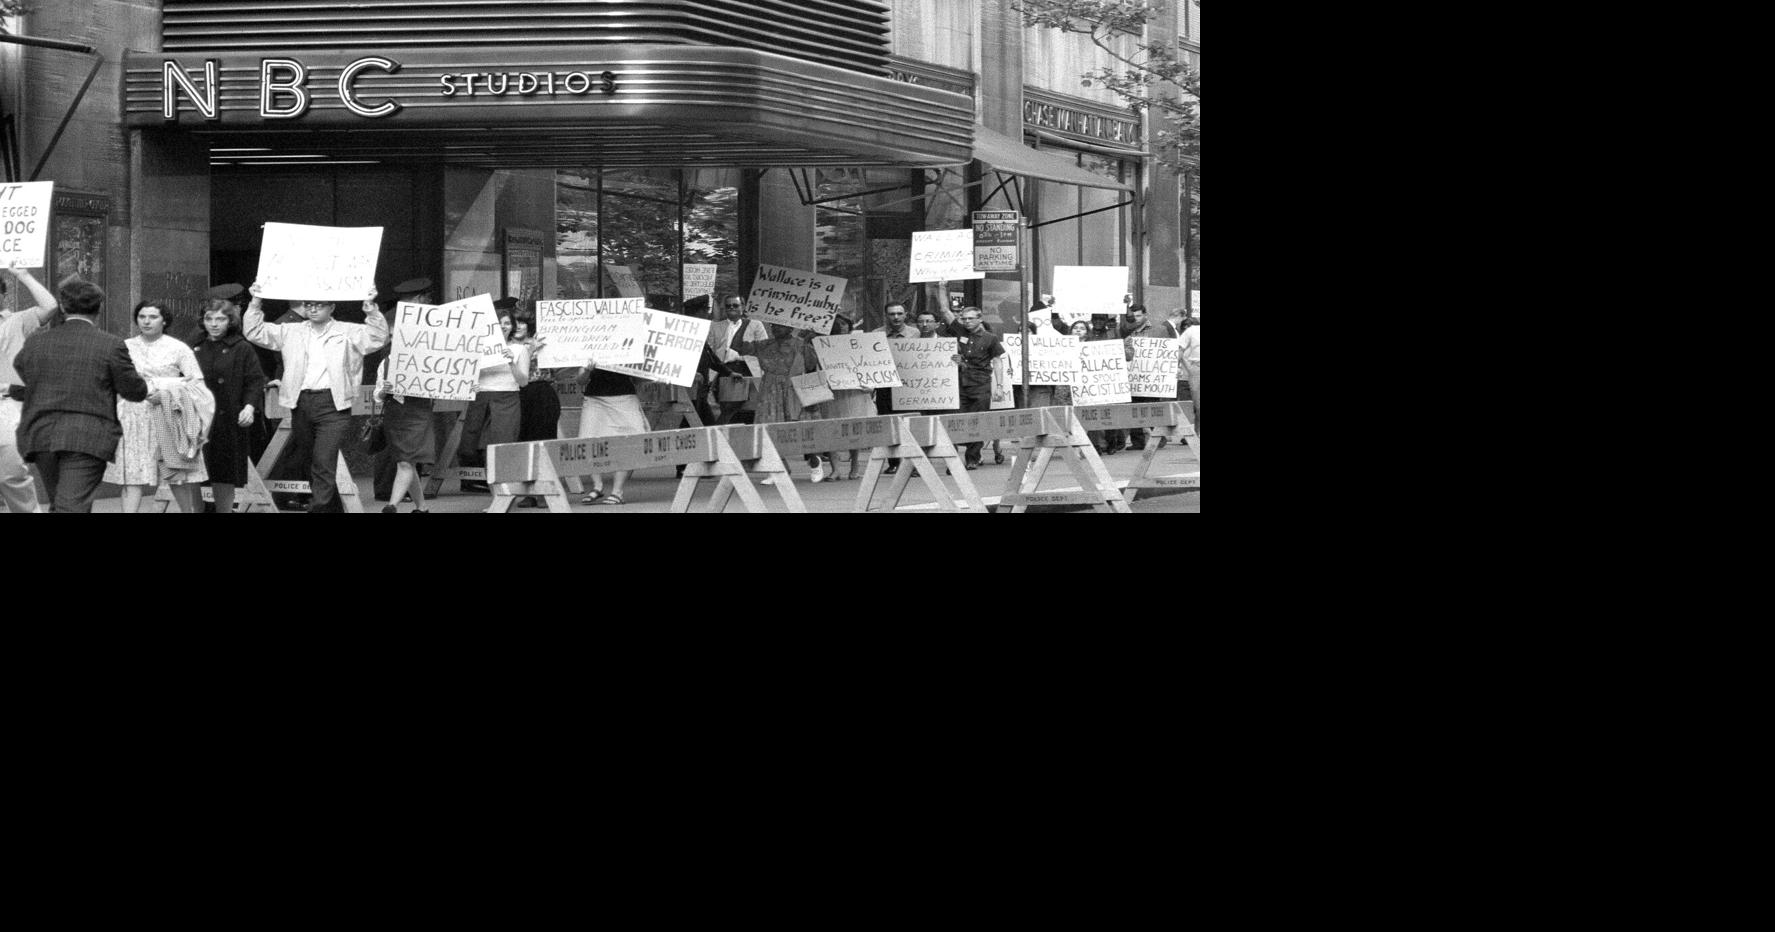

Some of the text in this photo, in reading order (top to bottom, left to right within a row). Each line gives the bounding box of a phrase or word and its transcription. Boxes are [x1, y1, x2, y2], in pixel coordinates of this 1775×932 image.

[439, 70, 616, 96] STUDIOS
[1023, 100, 1054, 127] CHASE
[4, 220, 36, 235] DOG
[975, 223, 1016, 232] NO STANDING
[914, 231, 974, 242] WALLAC
[0, 238, 22, 253] CE
[989, 246, 1002, 254] NO
[914, 250, 974, 262] CRIMINA
[979, 253, 1014, 261] PARKING
[759, 266, 835, 293] Wallace is a
[539, 300, 592, 317] FASCIST
[593, 298, 643, 315] WALLACE
[748, 300, 760, 313] is
[764, 301, 785, 316] he
[401, 305, 485, 330] FIGHT
[539, 324, 618, 335] BIRMINGHAM
[664, 316, 700, 335] WITH
[399, 329, 485, 353] WALLACE
[894, 341, 957, 352] WALLACE
[1032, 336, 1075, 349] WALLACE
[1149, 339, 1169, 349] HIS
[644, 343, 658, 359] IN
[1134, 349, 1154, 359] LICE
[396, 352, 479, 376] FASCISM
[1080, 357, 1124, 372] ALLACE
[395, 373, 476, 396] RACISM
[856, 369, 900, 386] RACISM
[1029, 371, 1079, 384] FASCIST
[1128, 373, 1168, 383] OAMS AT
[1071, 383, 1111, 399] RACIST
[1130, 383, 1176, 393] HE MOUTH
[898, 396, 955, 406] GERMANY
[560, 443, 587, 460] POLICE
[592, 441, 609, 458] LINE
[657, 436, 671, 452] NOT
[675, 434, 697, 450] CROSS
[459, 469, 482, 477] POLICE
[274, 481, 300, 489] POLICE
